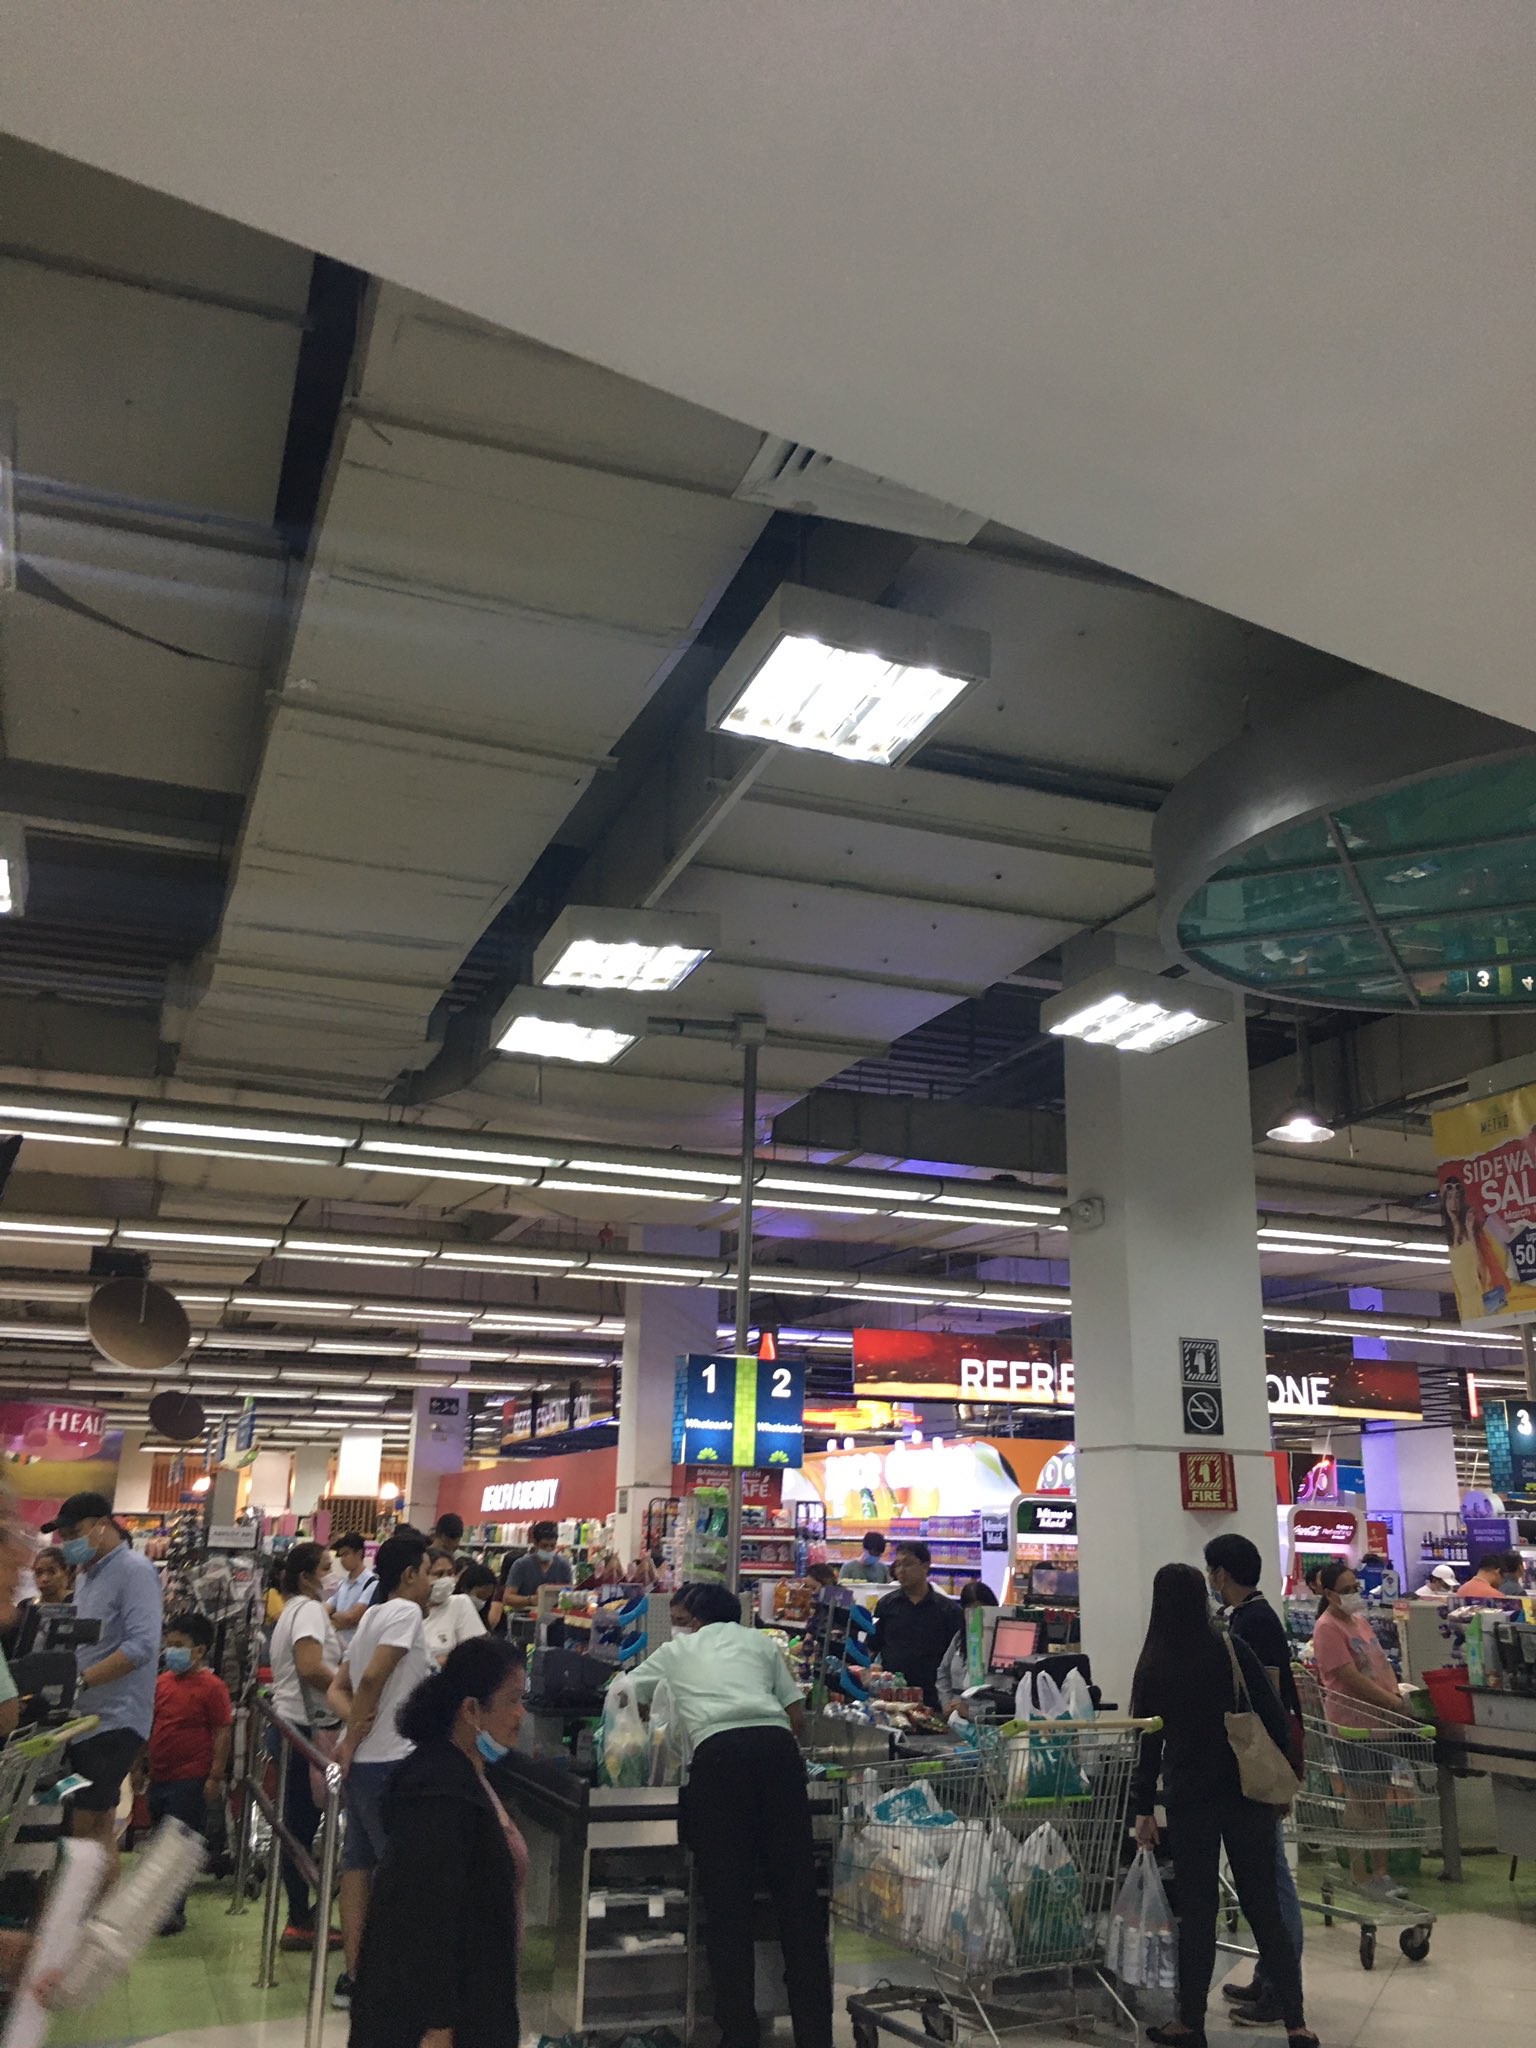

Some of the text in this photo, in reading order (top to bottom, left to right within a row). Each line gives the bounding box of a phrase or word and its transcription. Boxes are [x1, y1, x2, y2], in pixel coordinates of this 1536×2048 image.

[1463, 1148, 1536, 1185] SIDEWA
[1504, 1207, 1531, 1221] March
[1515, 1244, 1536, 1266] 50
[702, 1363, 716, 1393] 1
[771, 1368, 791, 1397] 2
[1516, 1409, 1533, 1436] 3
[1192, 1490, 1221, 1502] FIRE
[1036, 1507, 1073, 1519] Minute
[1039, 1518, 1067, 1528] Maid
